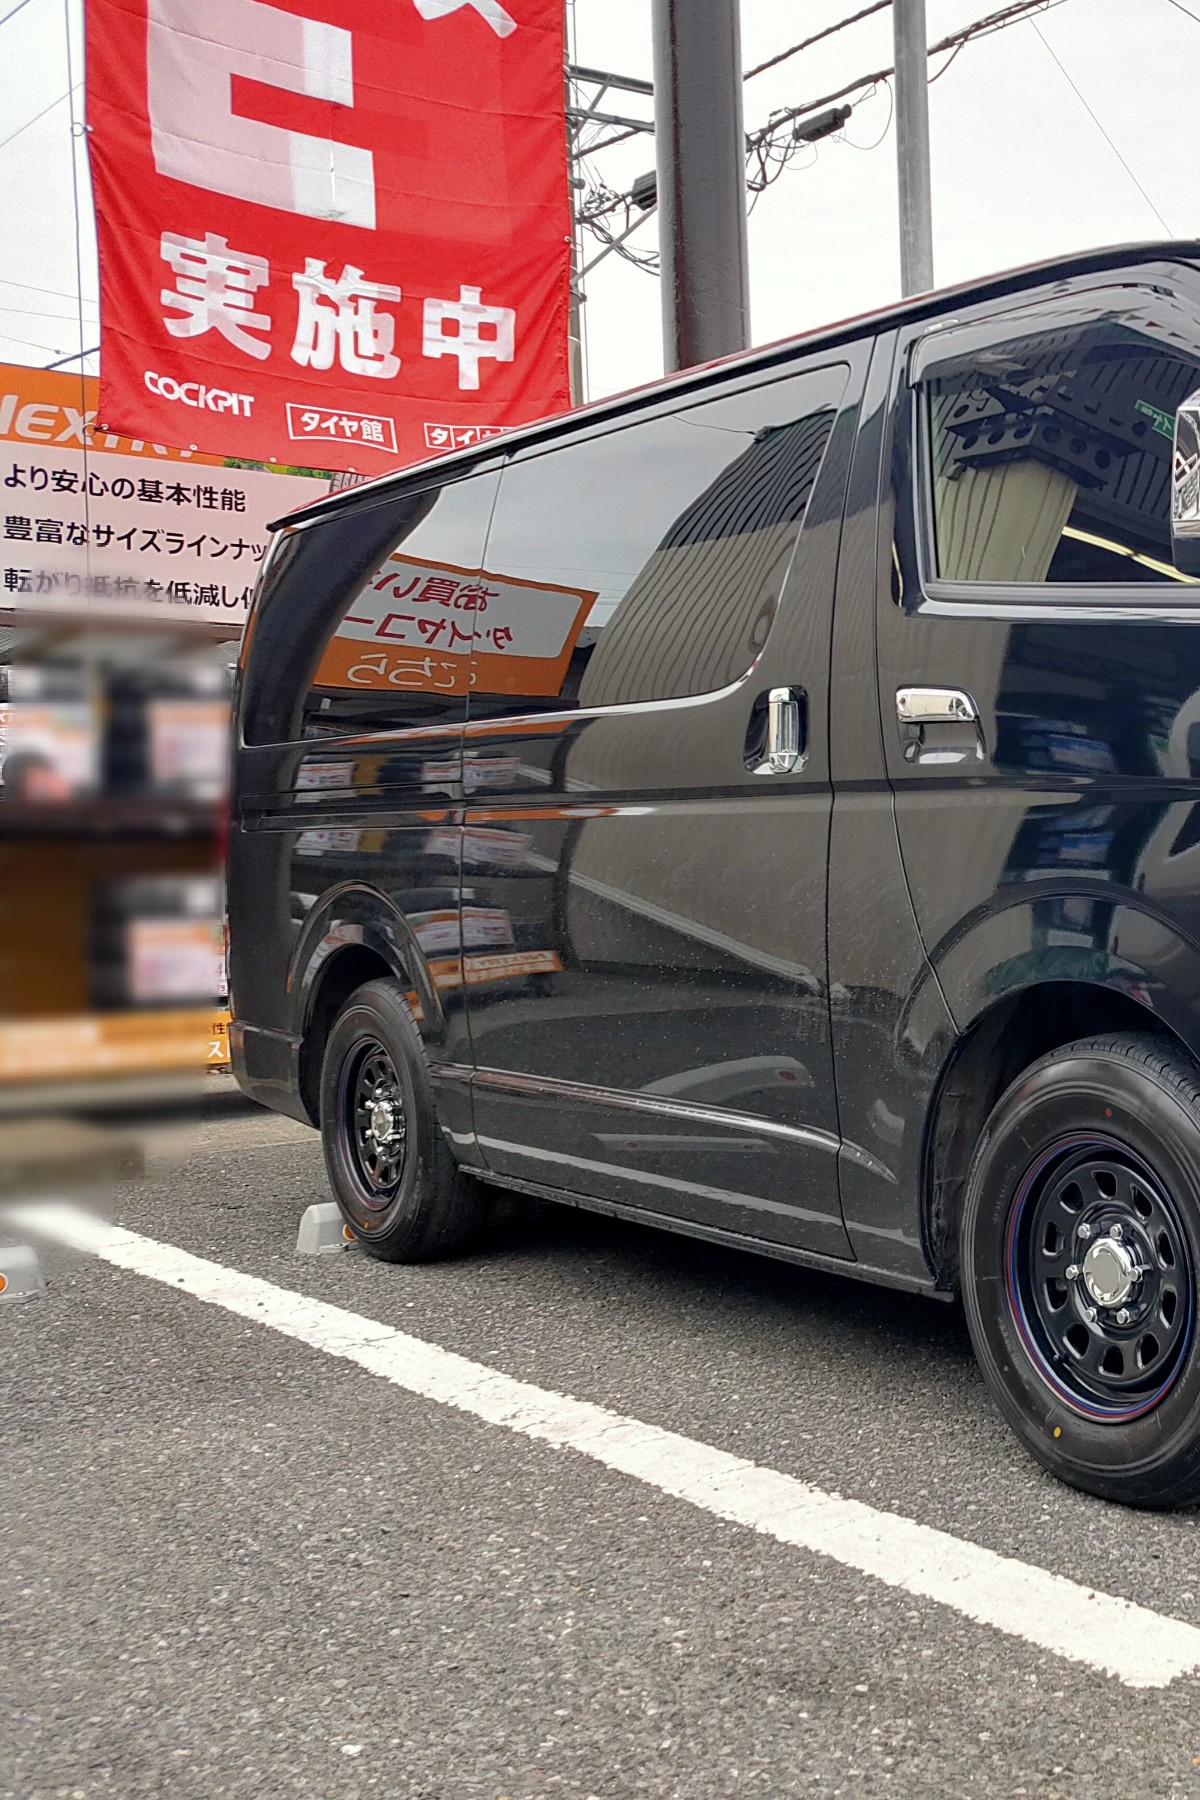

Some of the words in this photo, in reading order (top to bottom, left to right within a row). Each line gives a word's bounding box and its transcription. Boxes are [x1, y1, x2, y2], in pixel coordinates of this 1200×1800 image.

[160, 231, 516, 391] 実施中
[144, 370, 255, 418] COCKPIT
[299, 412, 385, 443] タイヤ館
[3, 463, 246, 513] より安心の基本性能
[3, 515, 267, 563] 豊富なサイズラインナッ
